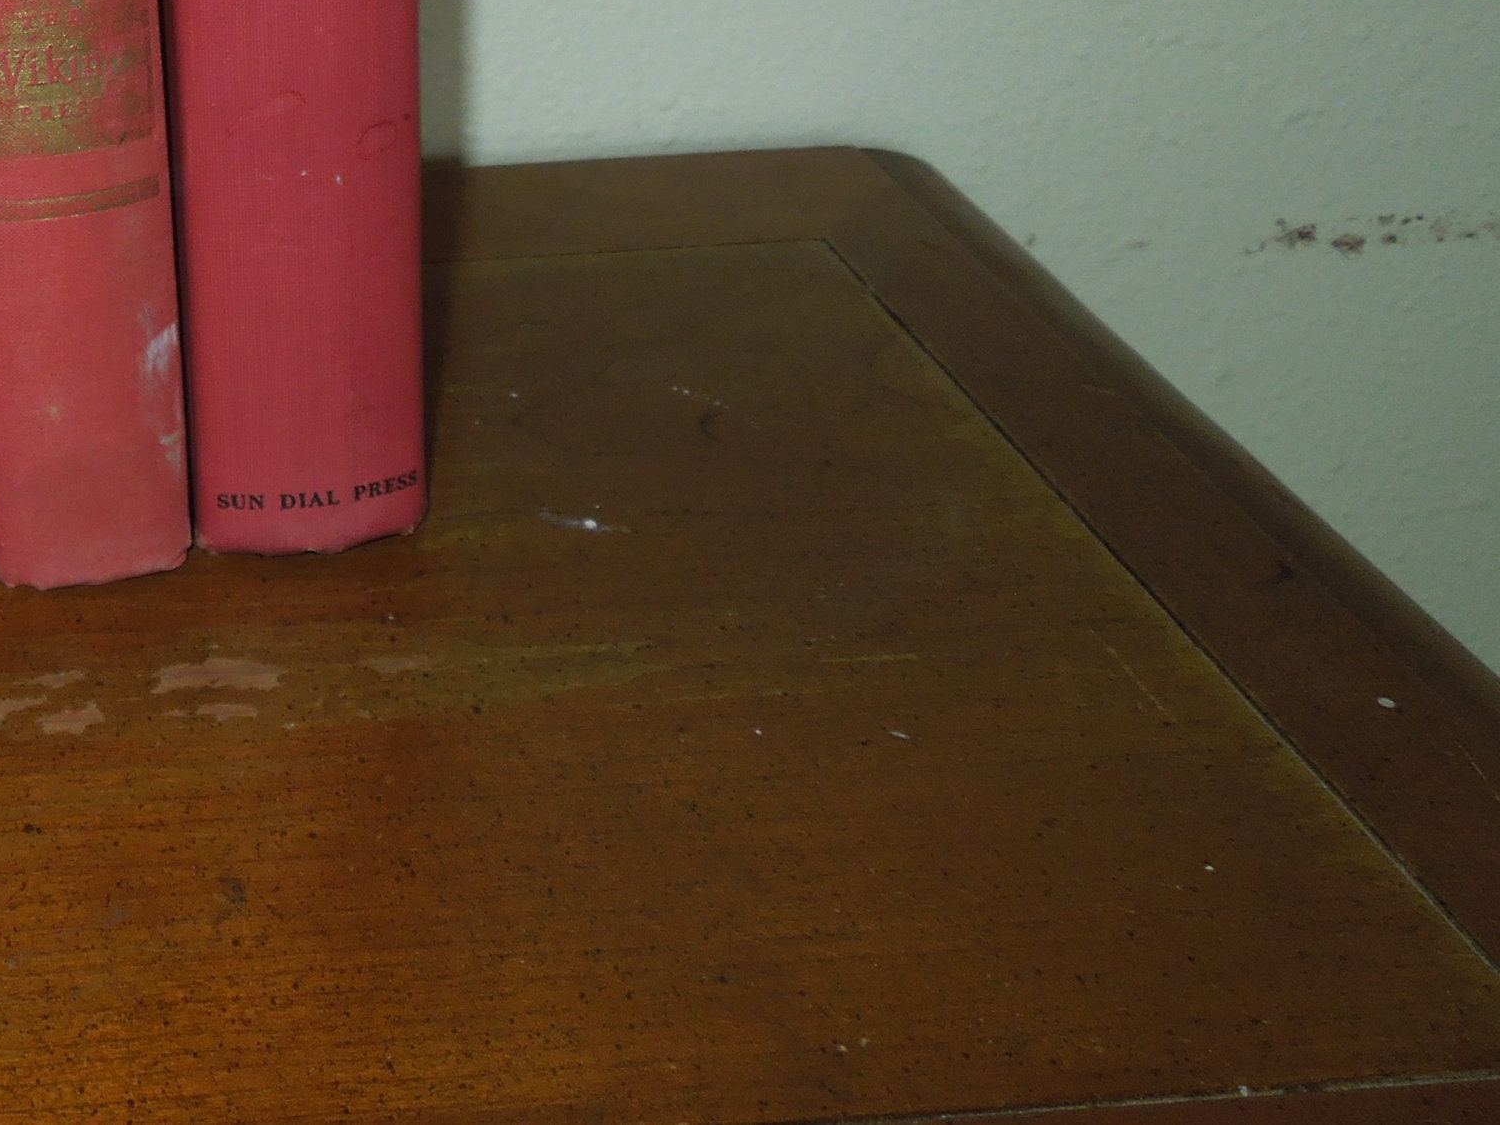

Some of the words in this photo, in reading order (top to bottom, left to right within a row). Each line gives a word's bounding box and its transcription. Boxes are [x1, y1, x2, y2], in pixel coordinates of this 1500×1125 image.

[21, 101, 103, 123] PRES
[217, 493, 265, 511] SUN
[280, 490, 342, 511] DIAL
[354, 469, 418, 502] PRESS
